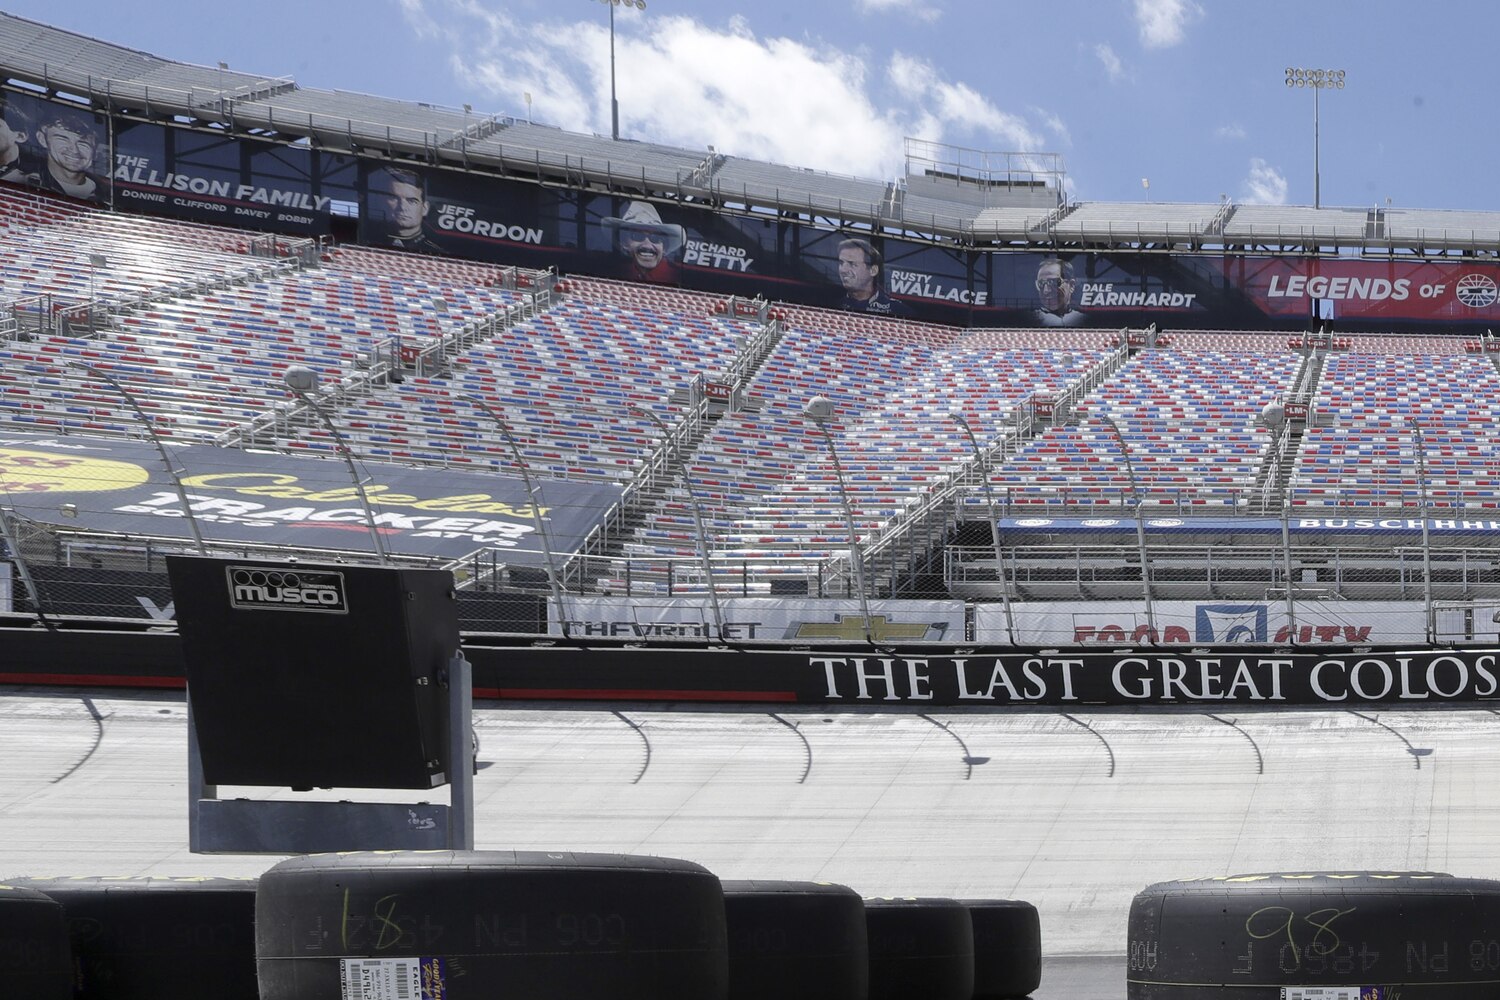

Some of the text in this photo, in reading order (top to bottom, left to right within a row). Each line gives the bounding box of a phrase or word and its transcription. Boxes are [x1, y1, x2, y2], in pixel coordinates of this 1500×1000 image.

[116, 153, 149, 169] THE
[106, 164, 331, 211] ALLISON FAMILY
[122, 189, 314, 225] DONNIE CLIFFORD DAVEY BOBBY
[437, 203, 476, 219] JEFF
[437, 214, 544, 245] GORDON
[682, 251, 754, 272] PETTY
[685, 240, 746, 257] RICHARD
[891, 270, 932, 284] RUSTY
[1082, 283, 1113, 293] DALE
[1268, 275, 1411, 300] LEGENDS
[1419, 284, 1445, 299] OF
[890, 279, 988, 306] WALLACE
[1080, 292, 1196, 308] EARNHARDT
[139, 491, 536, 541] TRACKER
[809, 657, 934, 700] THE
[950, 657, 1084, 701] LAST
[1111, 656, 1294, 701] GREAT
[341, 887, 403, 951] 18
[1246, 906, 1358, 964] 98
[1405, 939, 1449, 973] PN
